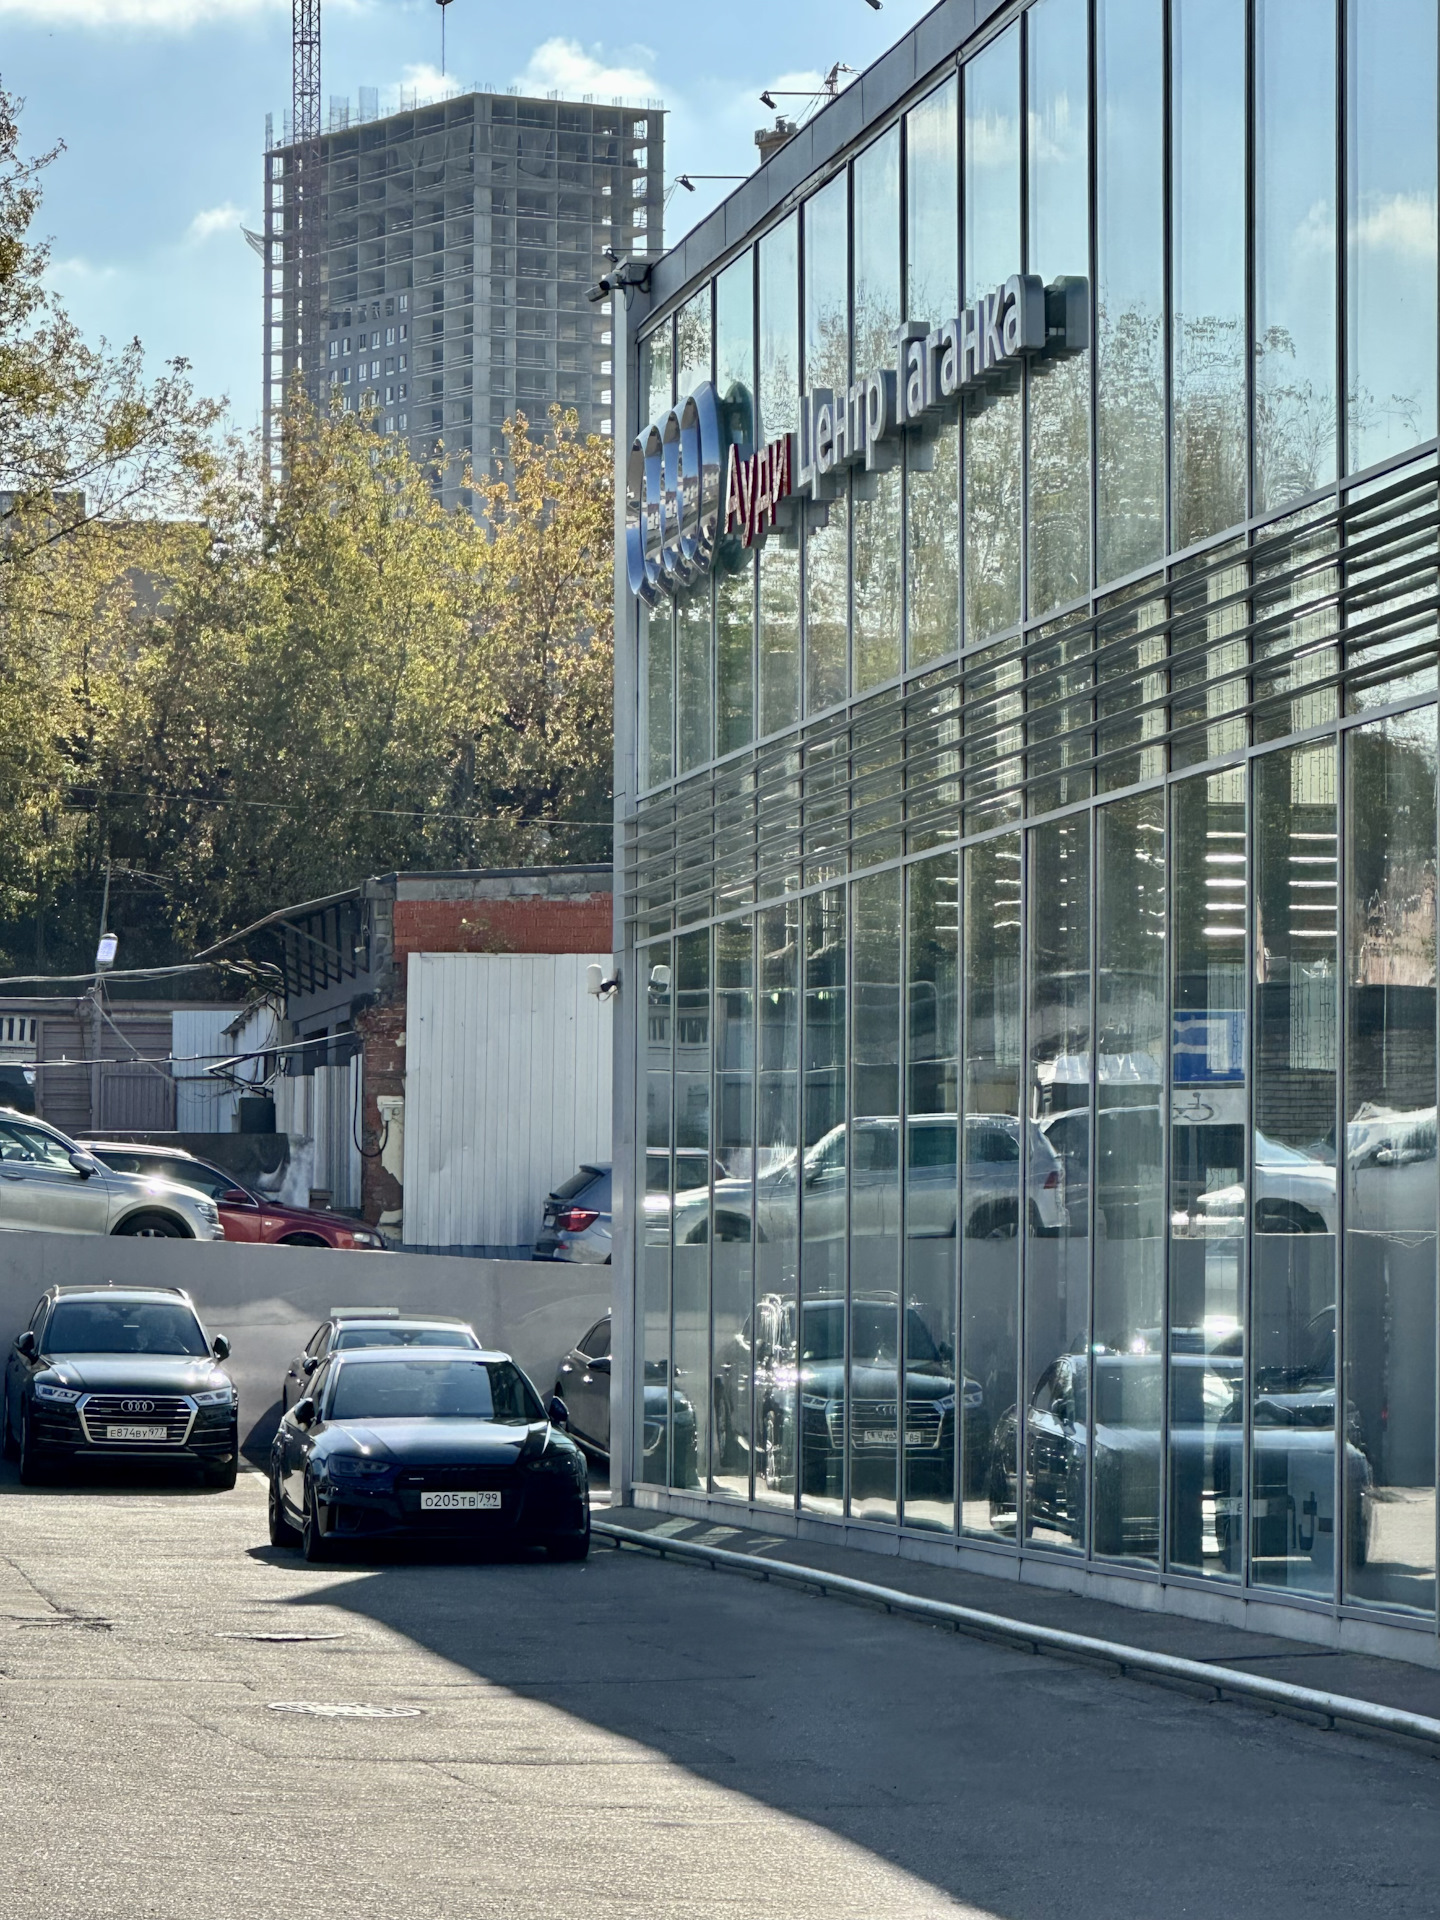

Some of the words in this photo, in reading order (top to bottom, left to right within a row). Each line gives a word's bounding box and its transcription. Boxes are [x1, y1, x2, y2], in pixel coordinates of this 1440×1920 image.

[724, 433, 791, 549] Ауди
[798, 370, 889, 500] Центр
[892, 274, 1038, 425] Таганка
